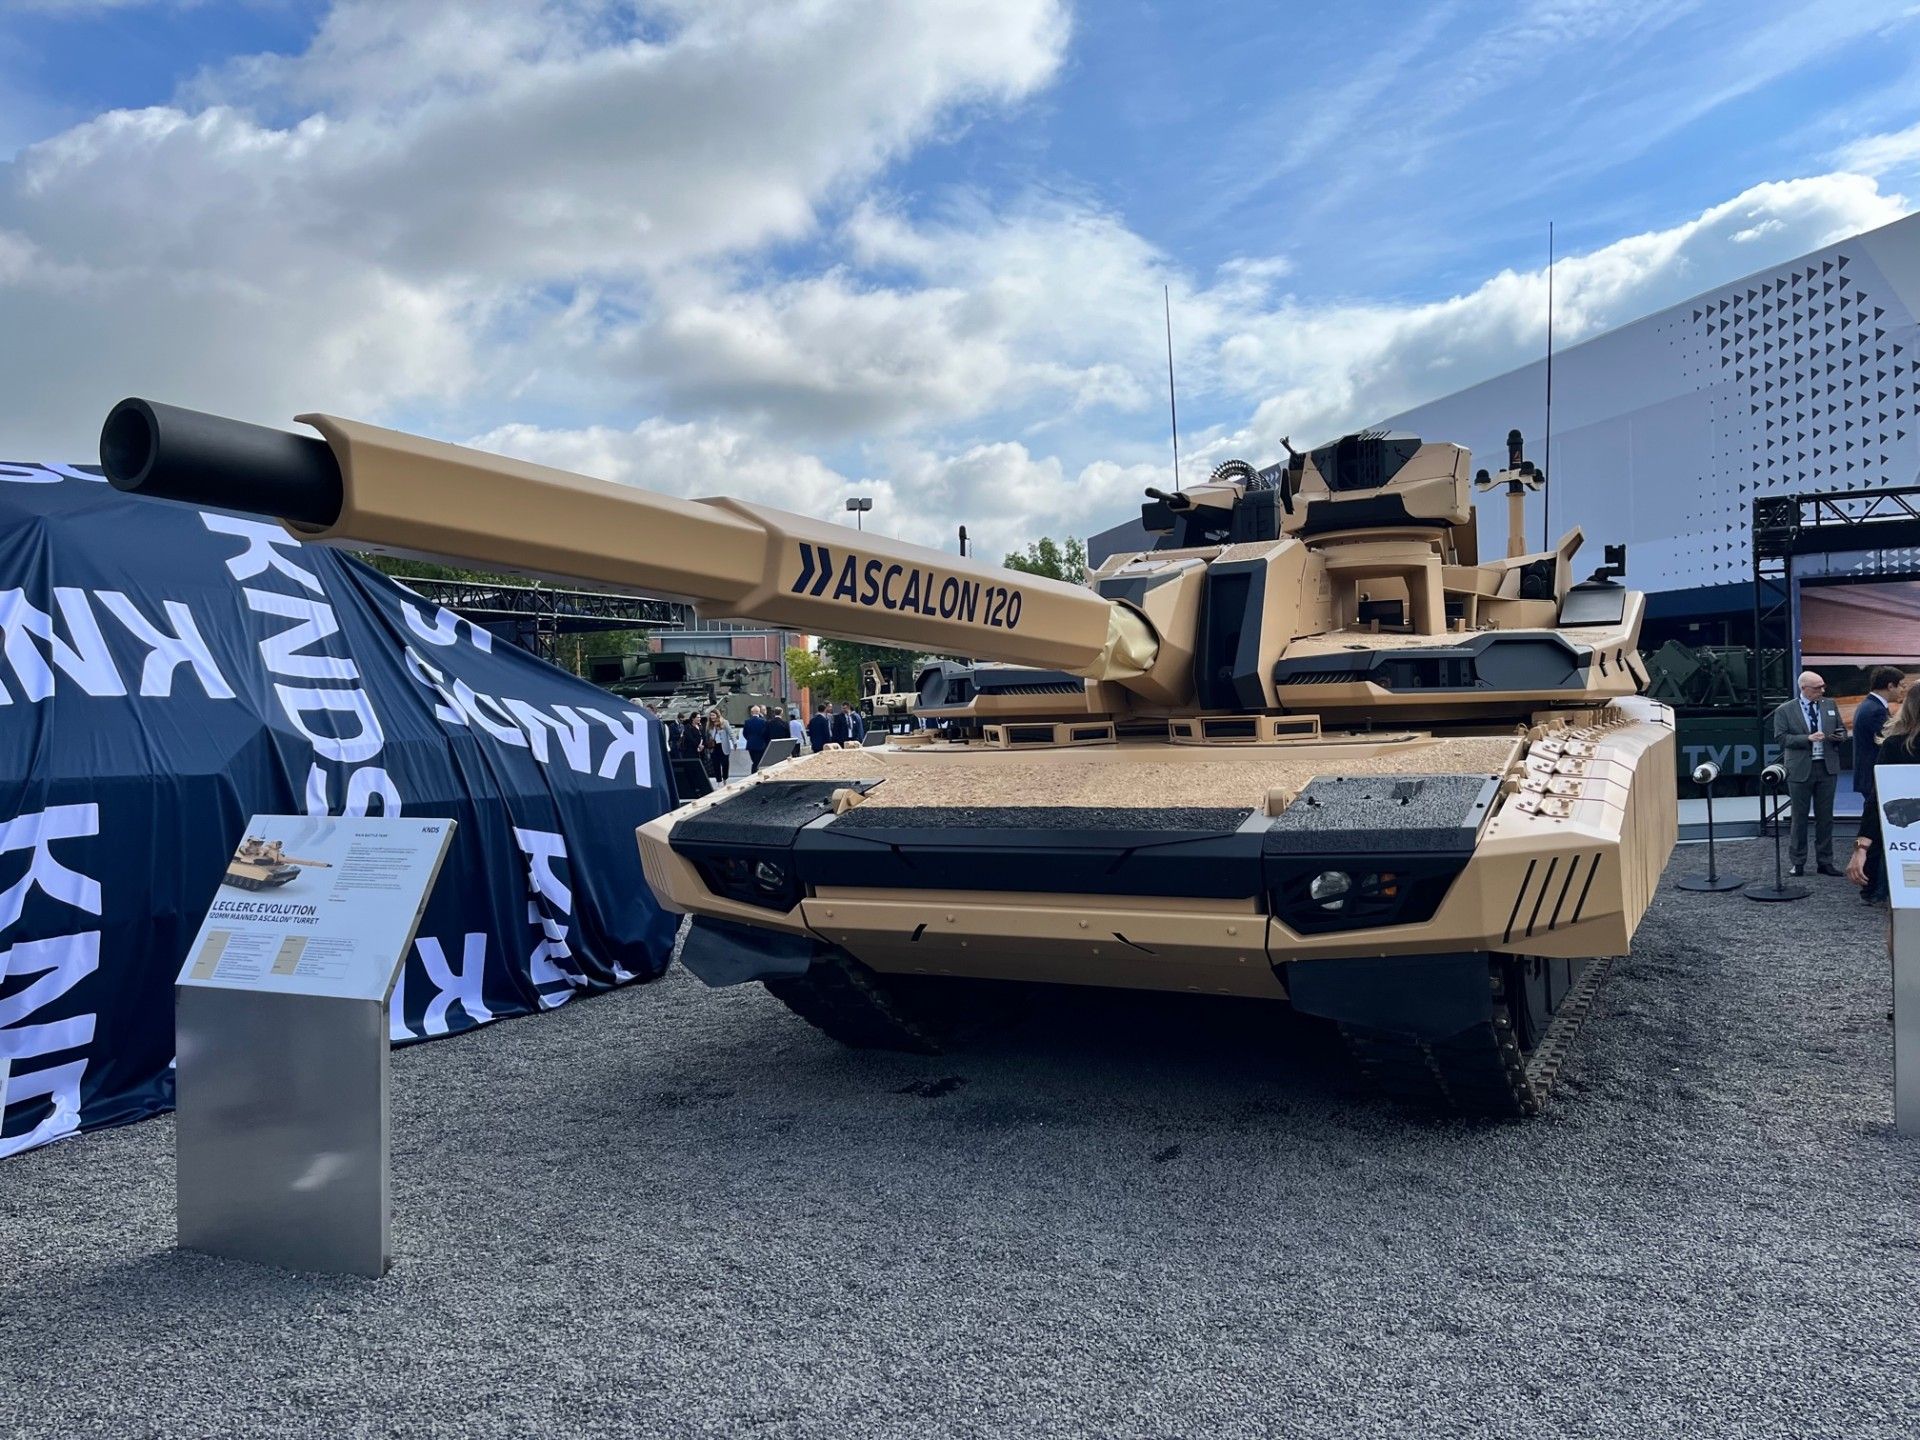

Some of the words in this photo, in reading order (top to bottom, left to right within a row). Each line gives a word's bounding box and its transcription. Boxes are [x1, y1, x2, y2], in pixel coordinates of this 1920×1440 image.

[833, 555, 980, 623] ASCALON
[983, 586, 1022, 629] 120
[0, 587, 237, 705] KN
[422, 826, 440, 834] KNDS
[1889, 842, 1920, 852] ASC
[212, 901, 257, 912] LECLERC
[257, 903, 317, 916] EVOLUTION
[230, 913, 258, 921] MANNED
[293, 917, 320, 925] TURRET
